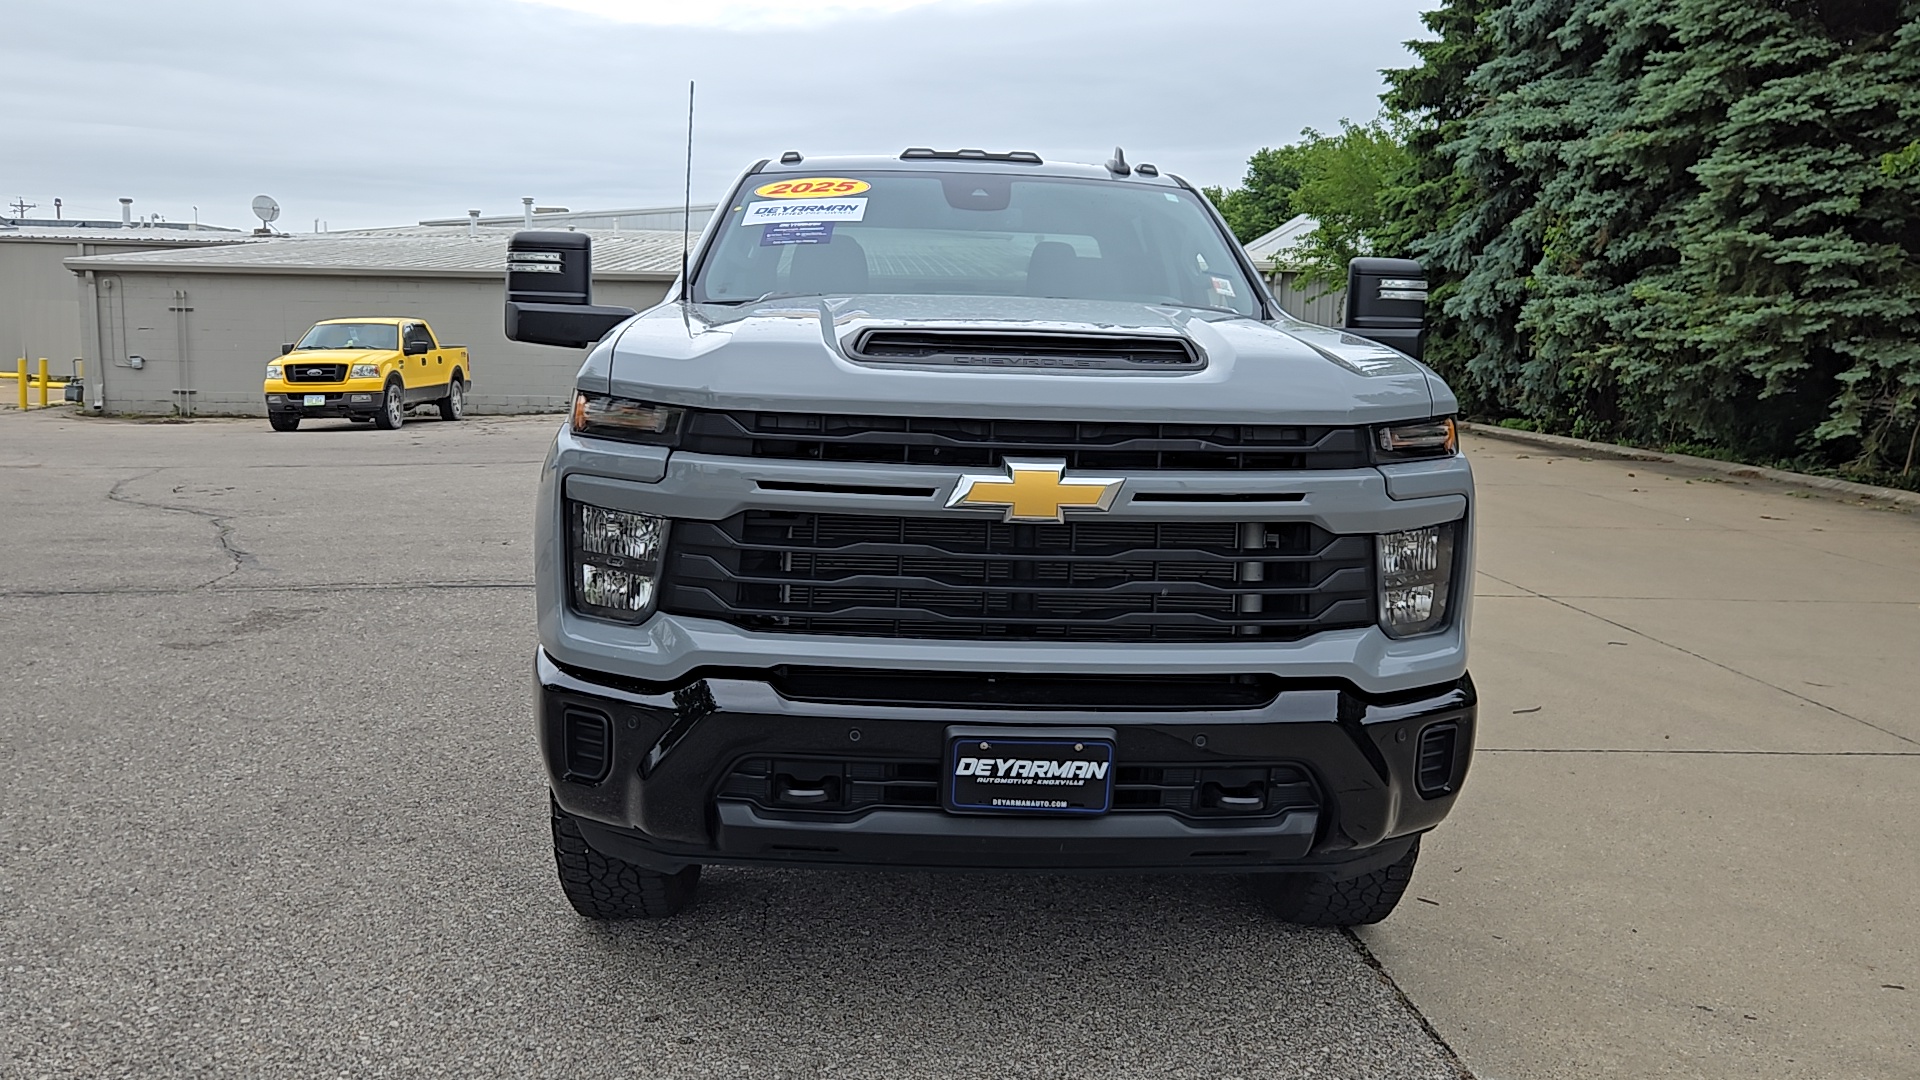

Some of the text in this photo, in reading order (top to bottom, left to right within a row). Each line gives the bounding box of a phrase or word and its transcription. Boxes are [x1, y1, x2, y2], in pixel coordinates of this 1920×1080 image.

[766, 182, 858, 194] 2025
[754, 205, 859, 215] DEYARMAN
[954, 356, 1106, 366] CHEVROLET
[955, 757, 1109, 779] DEYARMAN
[992, 798, 1067, 808] DEYARMANAUTO.COM
